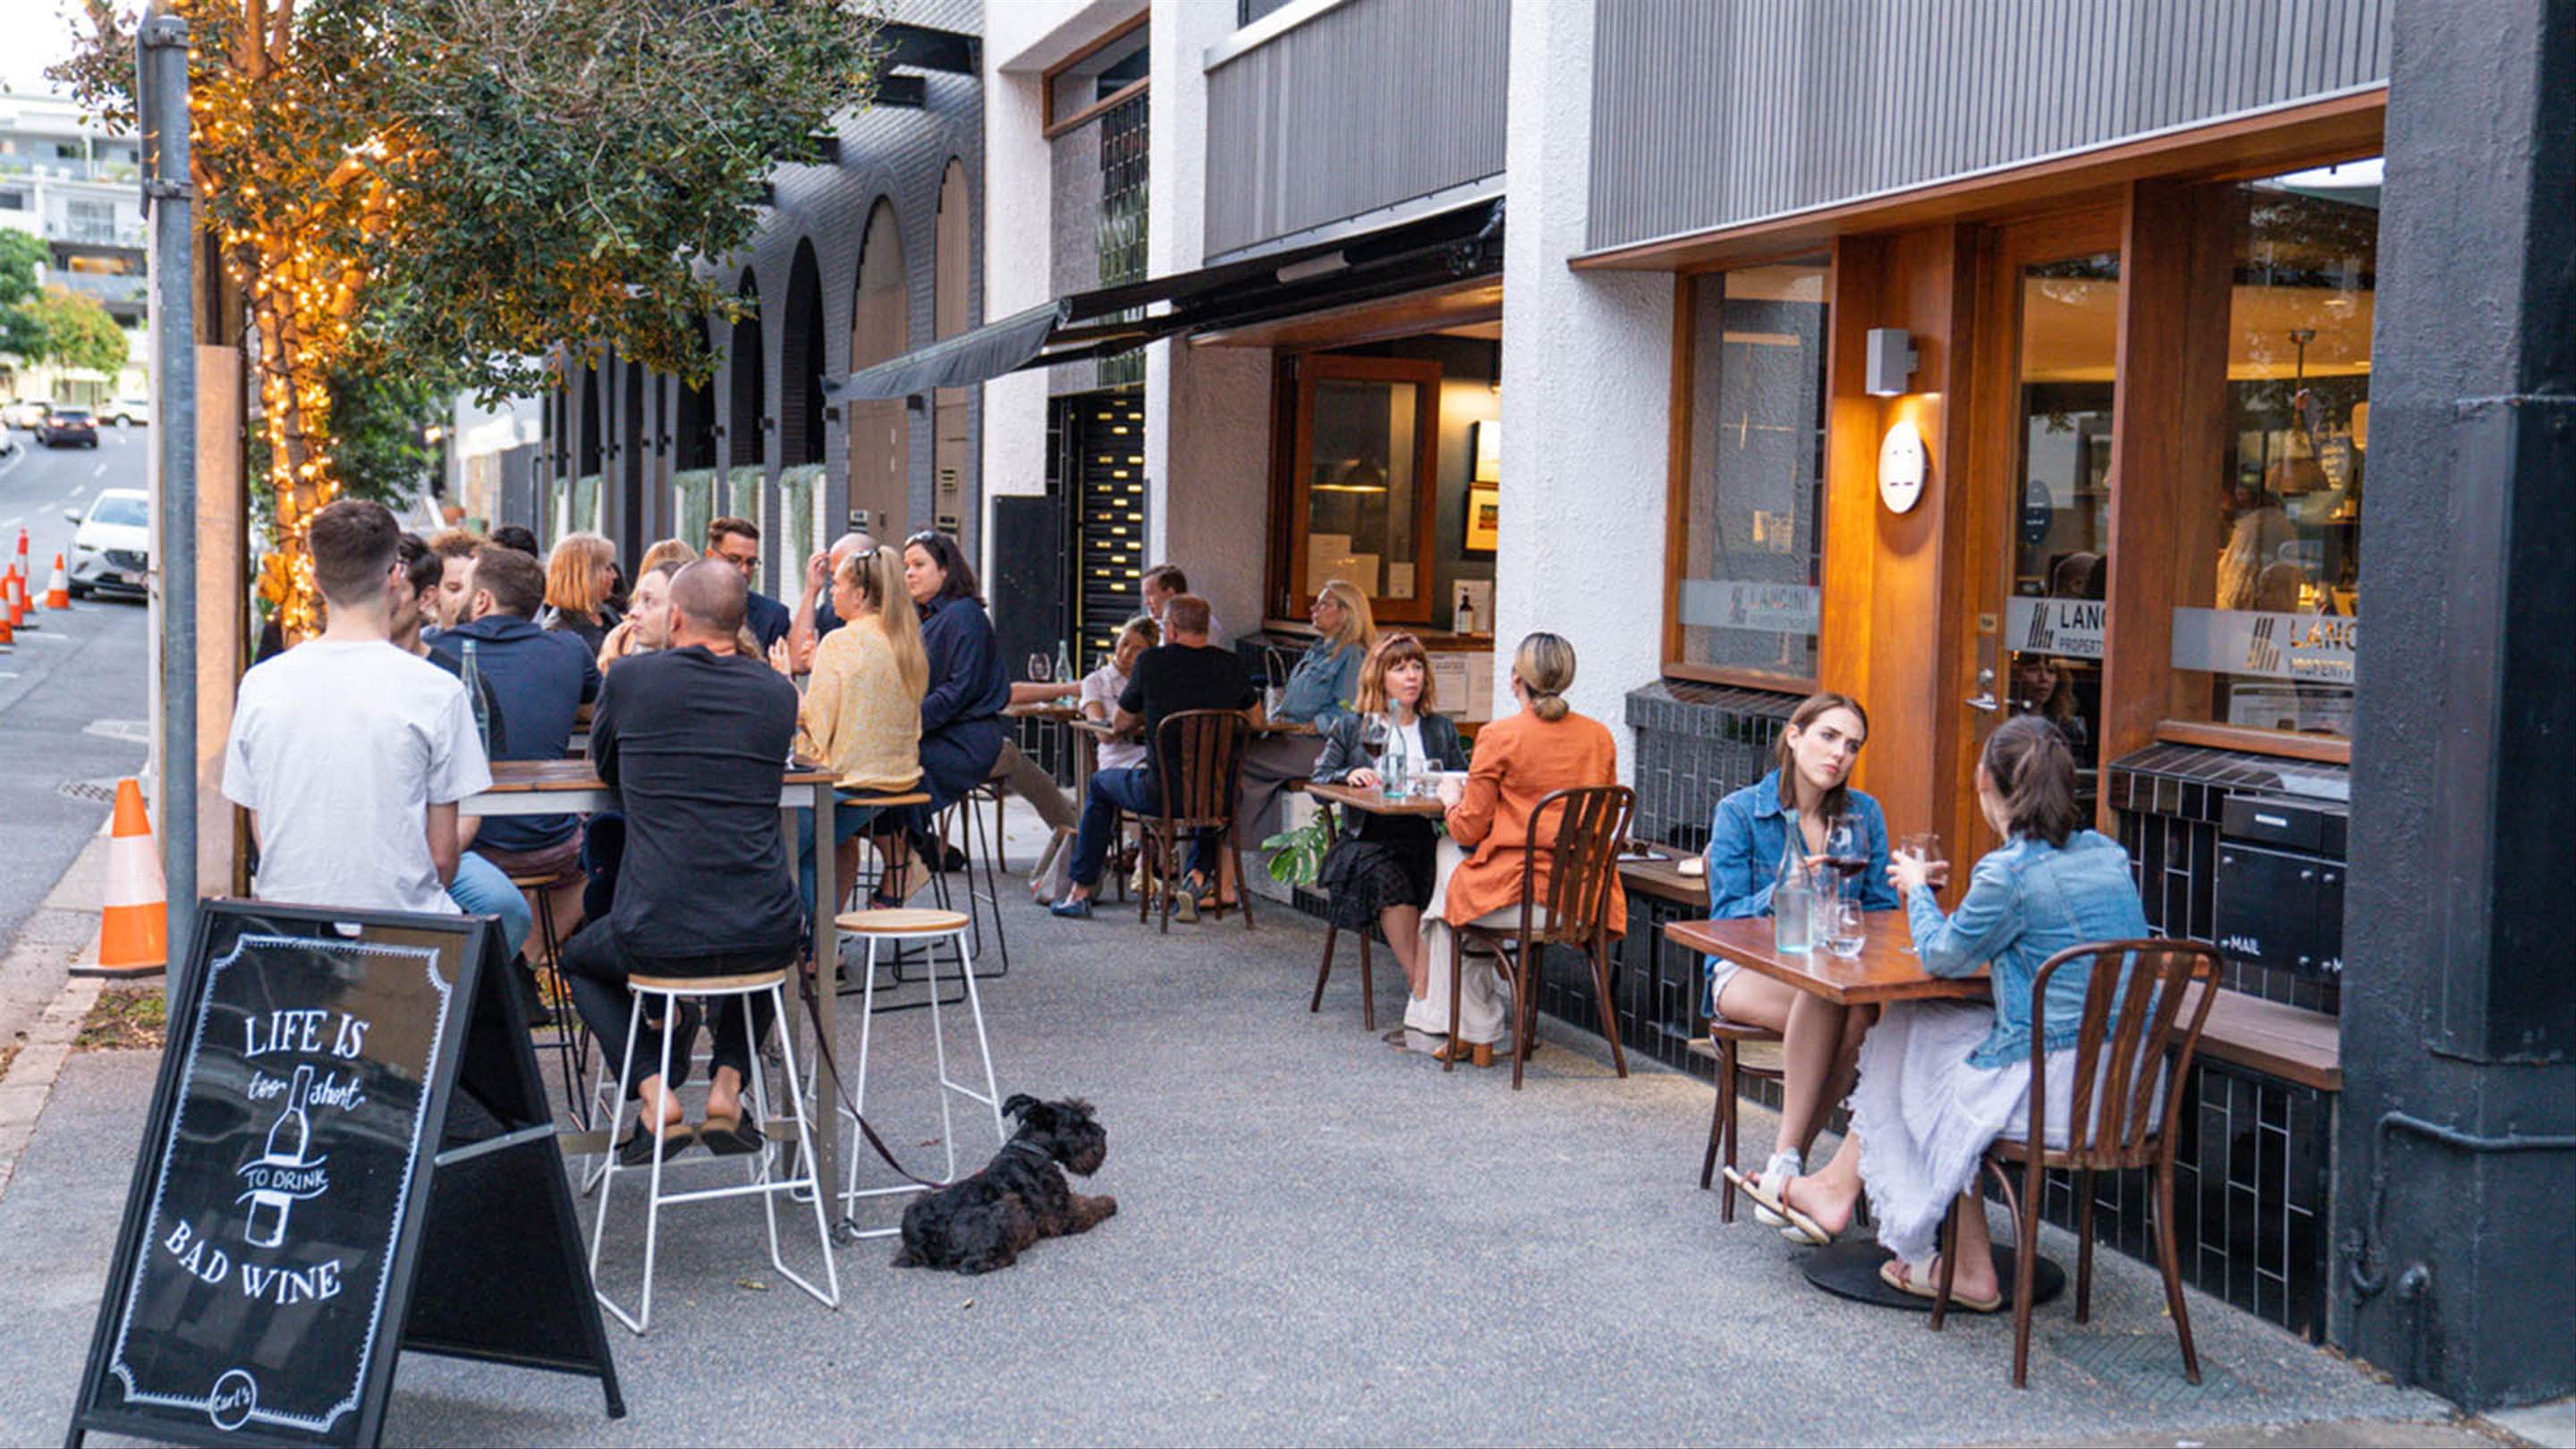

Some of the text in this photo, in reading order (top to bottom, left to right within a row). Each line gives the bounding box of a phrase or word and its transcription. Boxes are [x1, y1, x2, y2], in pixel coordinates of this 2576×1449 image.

[2061, 602, 2106, 630] LAN
[2060, 637, 2105, 654] PROPERT
[2231, 935, 2261, 956] MAIL
[244, 1010, 370, 1059] LIFE IS
[248, 1071, 366, 1111] too short
[245, 1168, 329, 1190] TO DRINK
[164, 1219, 341, 1304] BAD WINE
